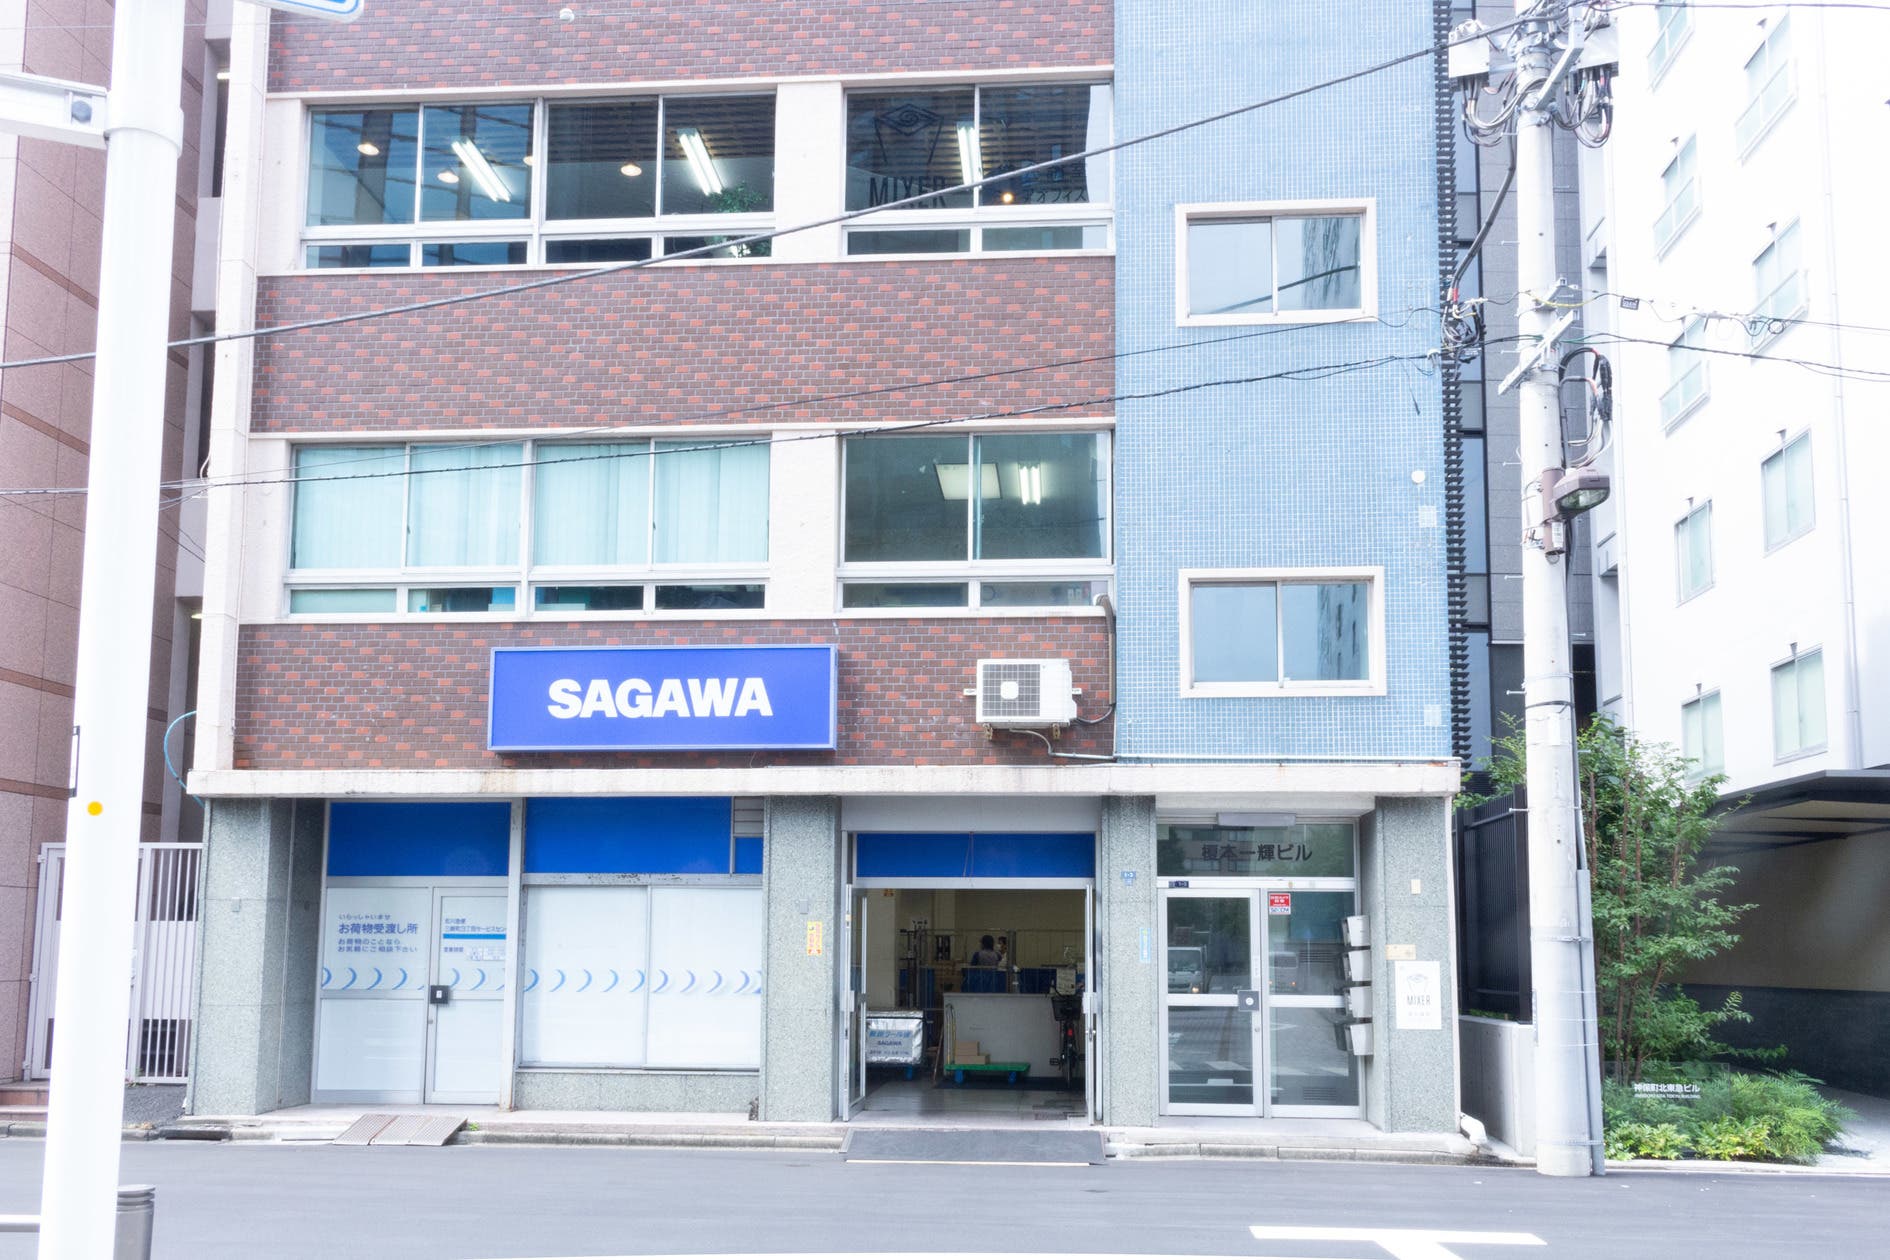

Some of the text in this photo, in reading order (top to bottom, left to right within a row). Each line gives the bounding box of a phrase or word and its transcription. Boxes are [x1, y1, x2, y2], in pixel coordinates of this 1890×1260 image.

[868, 176, 946, 208] MIXER
[547, 677, 774, 719] SAGAWA
[338, 923, 418, 934] お荷物受渡し所
